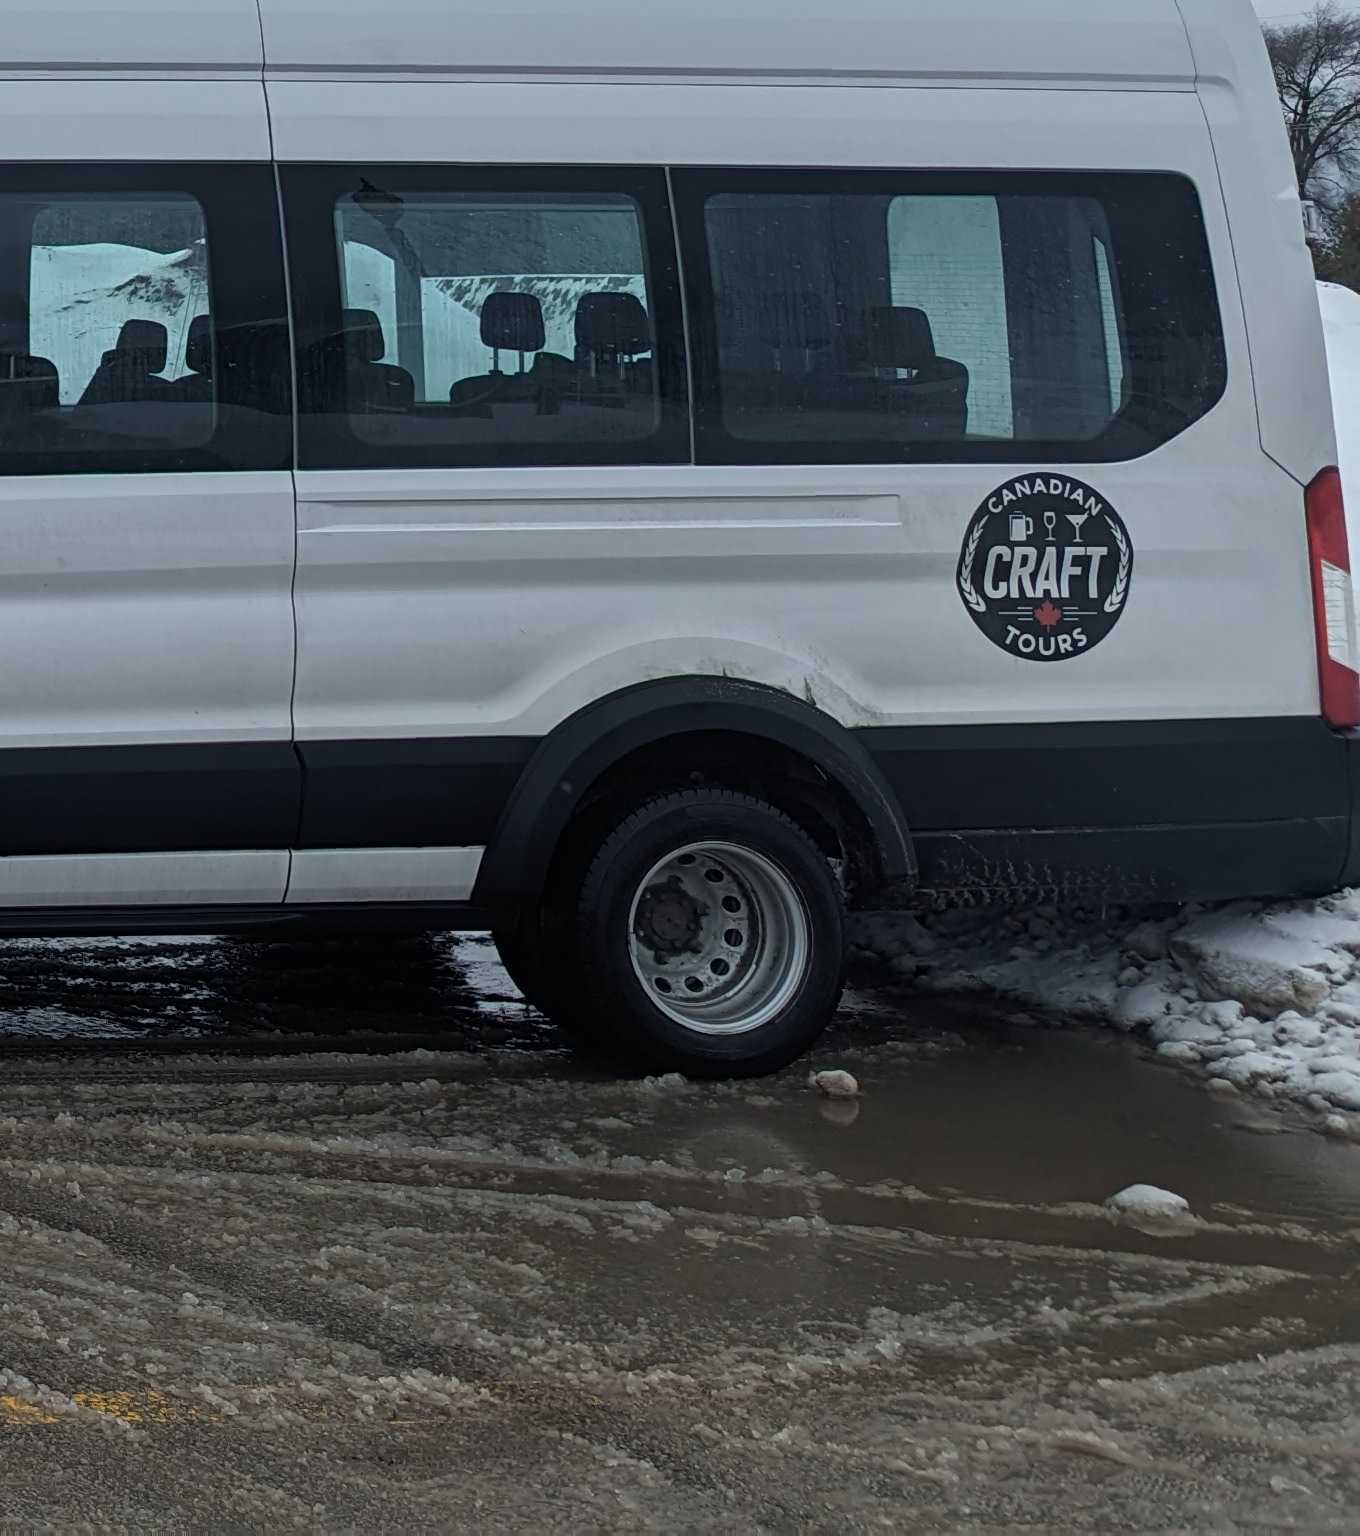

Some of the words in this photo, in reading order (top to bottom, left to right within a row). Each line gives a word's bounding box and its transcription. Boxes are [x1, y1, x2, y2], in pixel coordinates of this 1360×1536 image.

[988, 478, 1103, 517] CANADIAN
[983, 545, 1108, 599] CRAFT
[1004, 625, 1088, 656] TOURS
